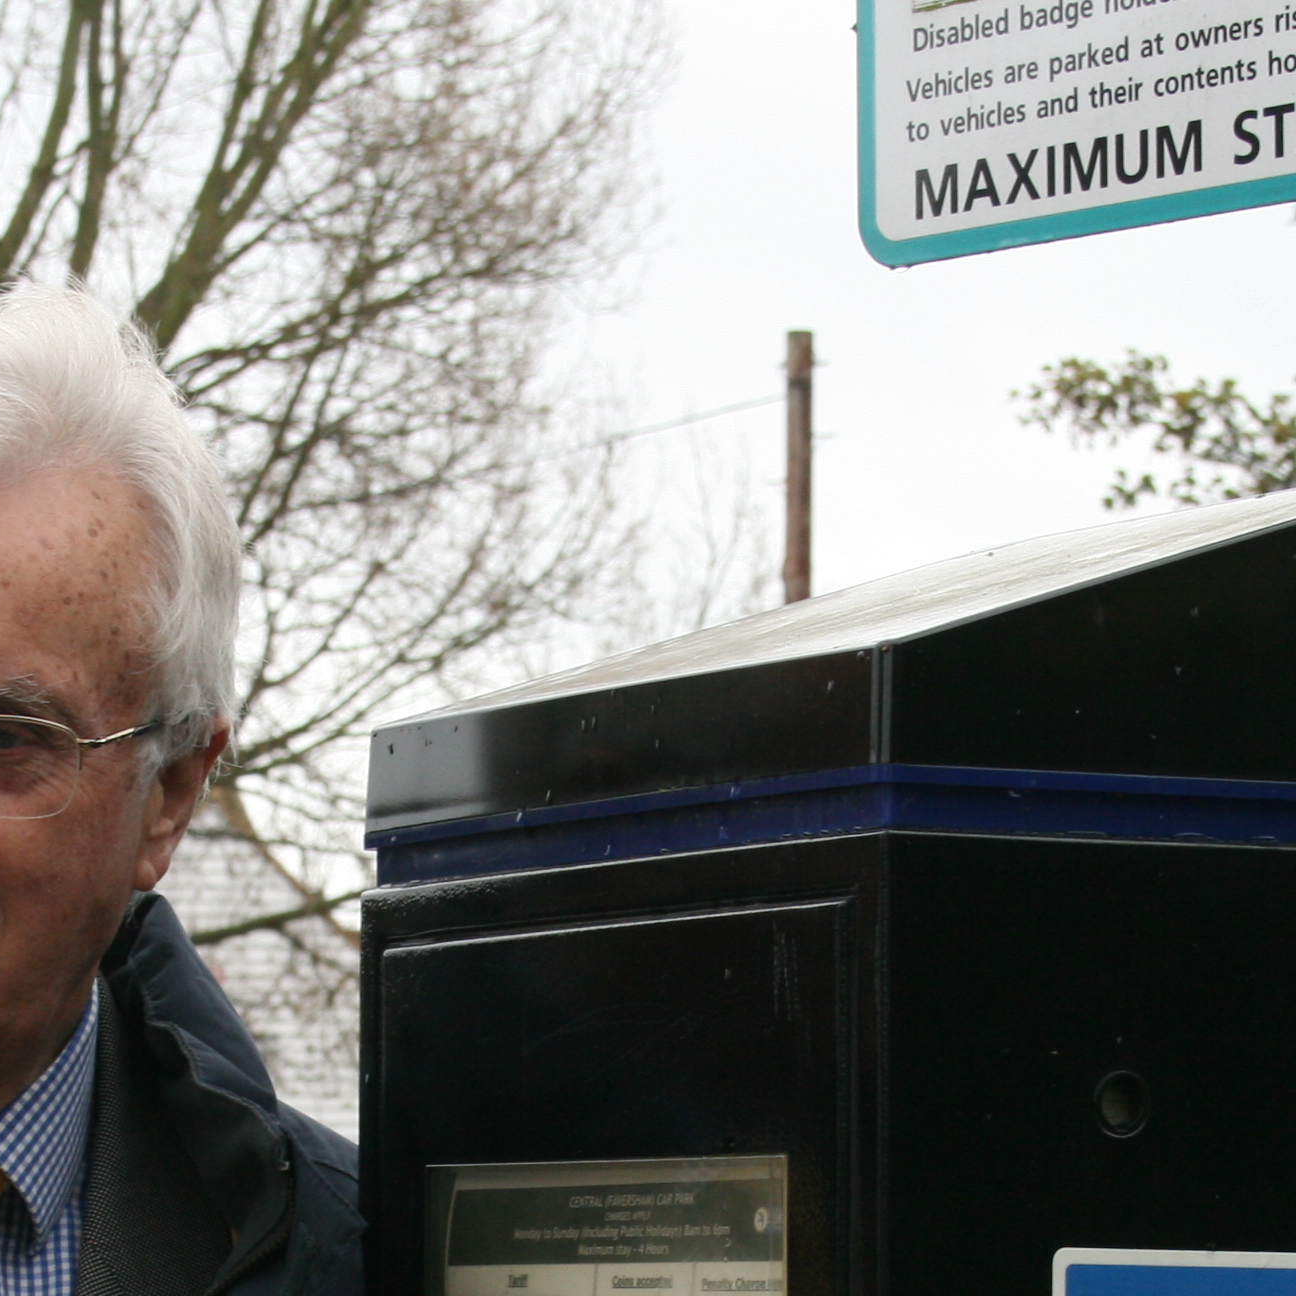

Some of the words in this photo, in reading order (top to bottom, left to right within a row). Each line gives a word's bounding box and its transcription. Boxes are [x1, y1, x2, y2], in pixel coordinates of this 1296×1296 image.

[905, 66, 993, 102] Vehicles
[1003, 61, 1039, 84] are
[1048, 35, 1130, 83] parked
[1140, 33, 1164, 58] at
[1174, 16, 1264, 52] owners
[912, 7, 1009, 53] Disabled
[1019, 0, 1093, 29] badge
[906, 120, 930, 143] to
[940, 101, 1026, 138] vehicles
[1036, 86, 1079, 119] and
[1088, 76, 1144, 109] their
[1153, 58, 1258, 98] contents
[914, 117, 1206, 221] MAXIMUM
[656, 1192, 673, 1206] CAR
